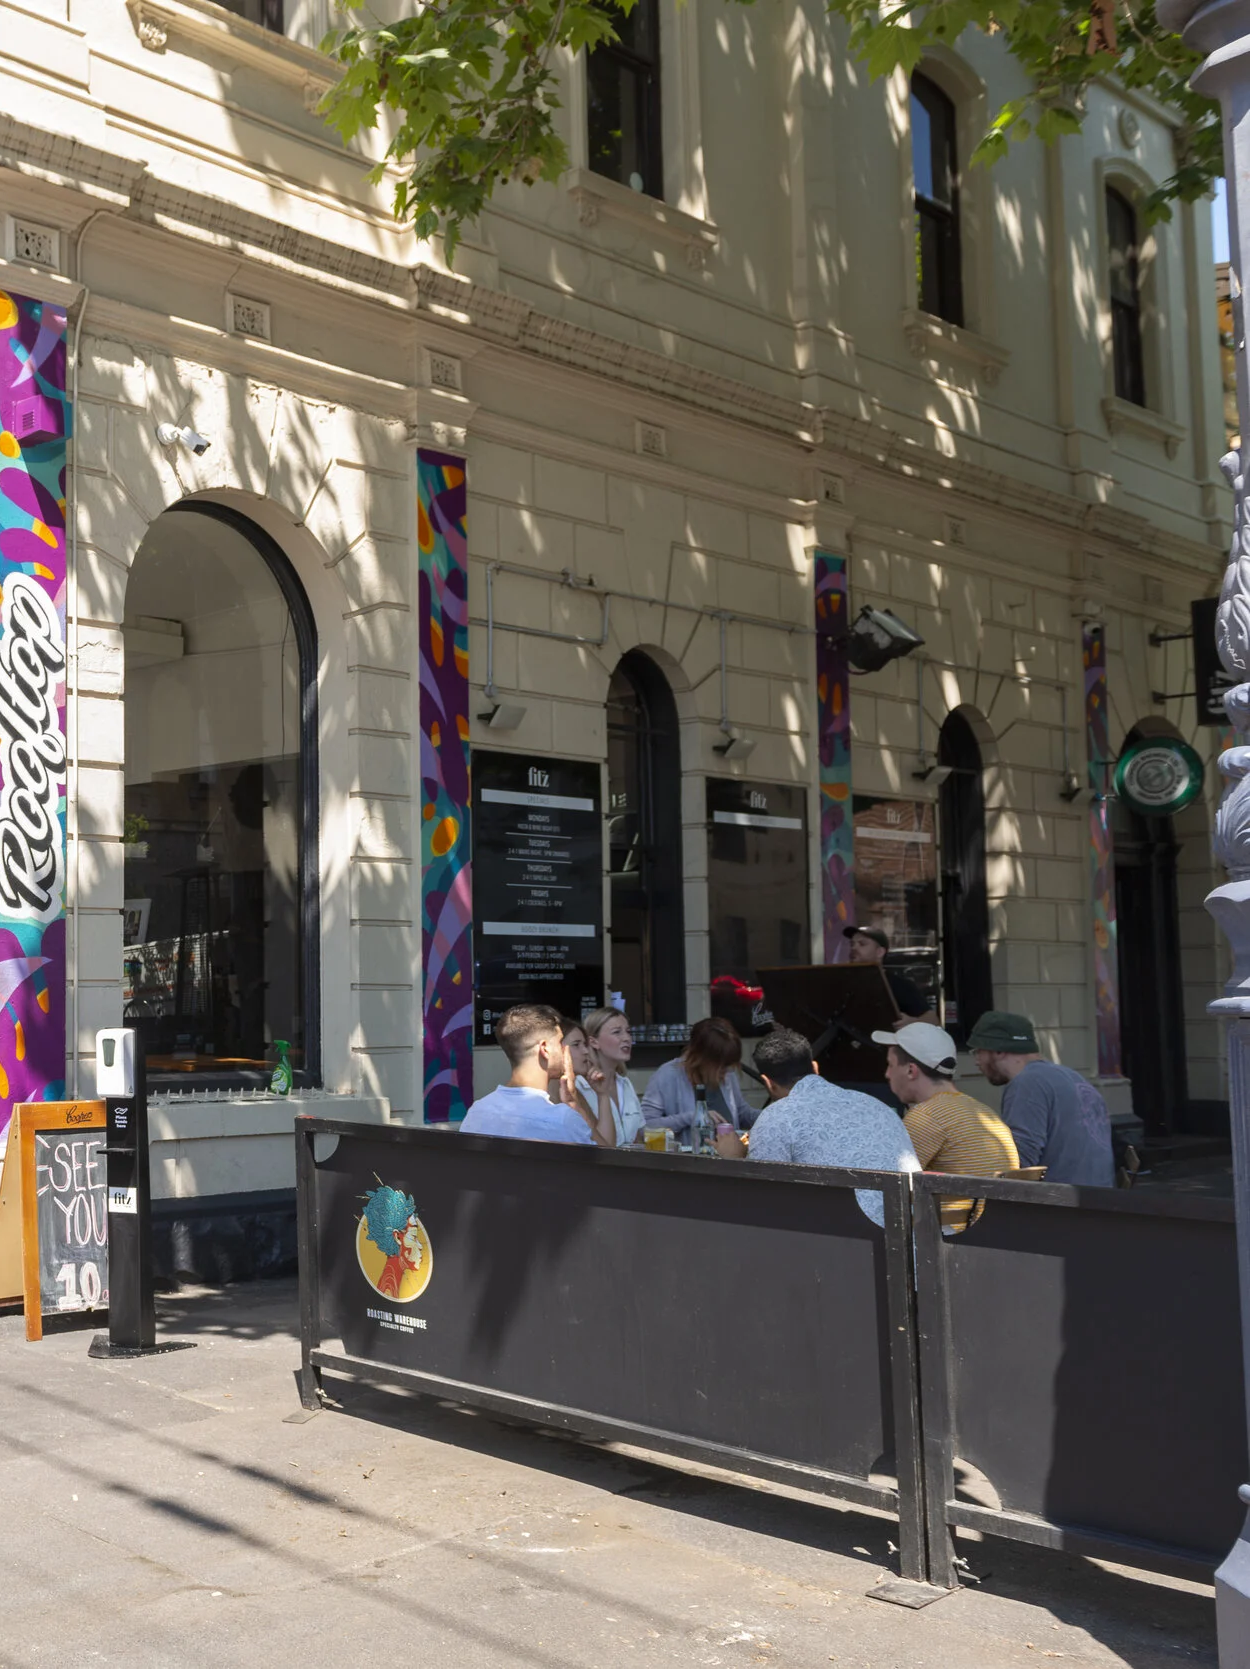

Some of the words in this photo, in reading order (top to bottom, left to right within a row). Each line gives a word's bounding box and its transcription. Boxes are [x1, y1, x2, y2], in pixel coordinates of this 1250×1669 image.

[528, 767, 549, 787] fitz
[49, 1142, 107, 1192] SEE
[114, 1192, 132, 1205] fitz
[54, 1193, 107, 1246] YOU
[366, 1308, 393, 1321] ROASTING
[394, 1313, 427, 1329] WAREHOUSE
[400, 1325, 414, 1334] COFFEE
